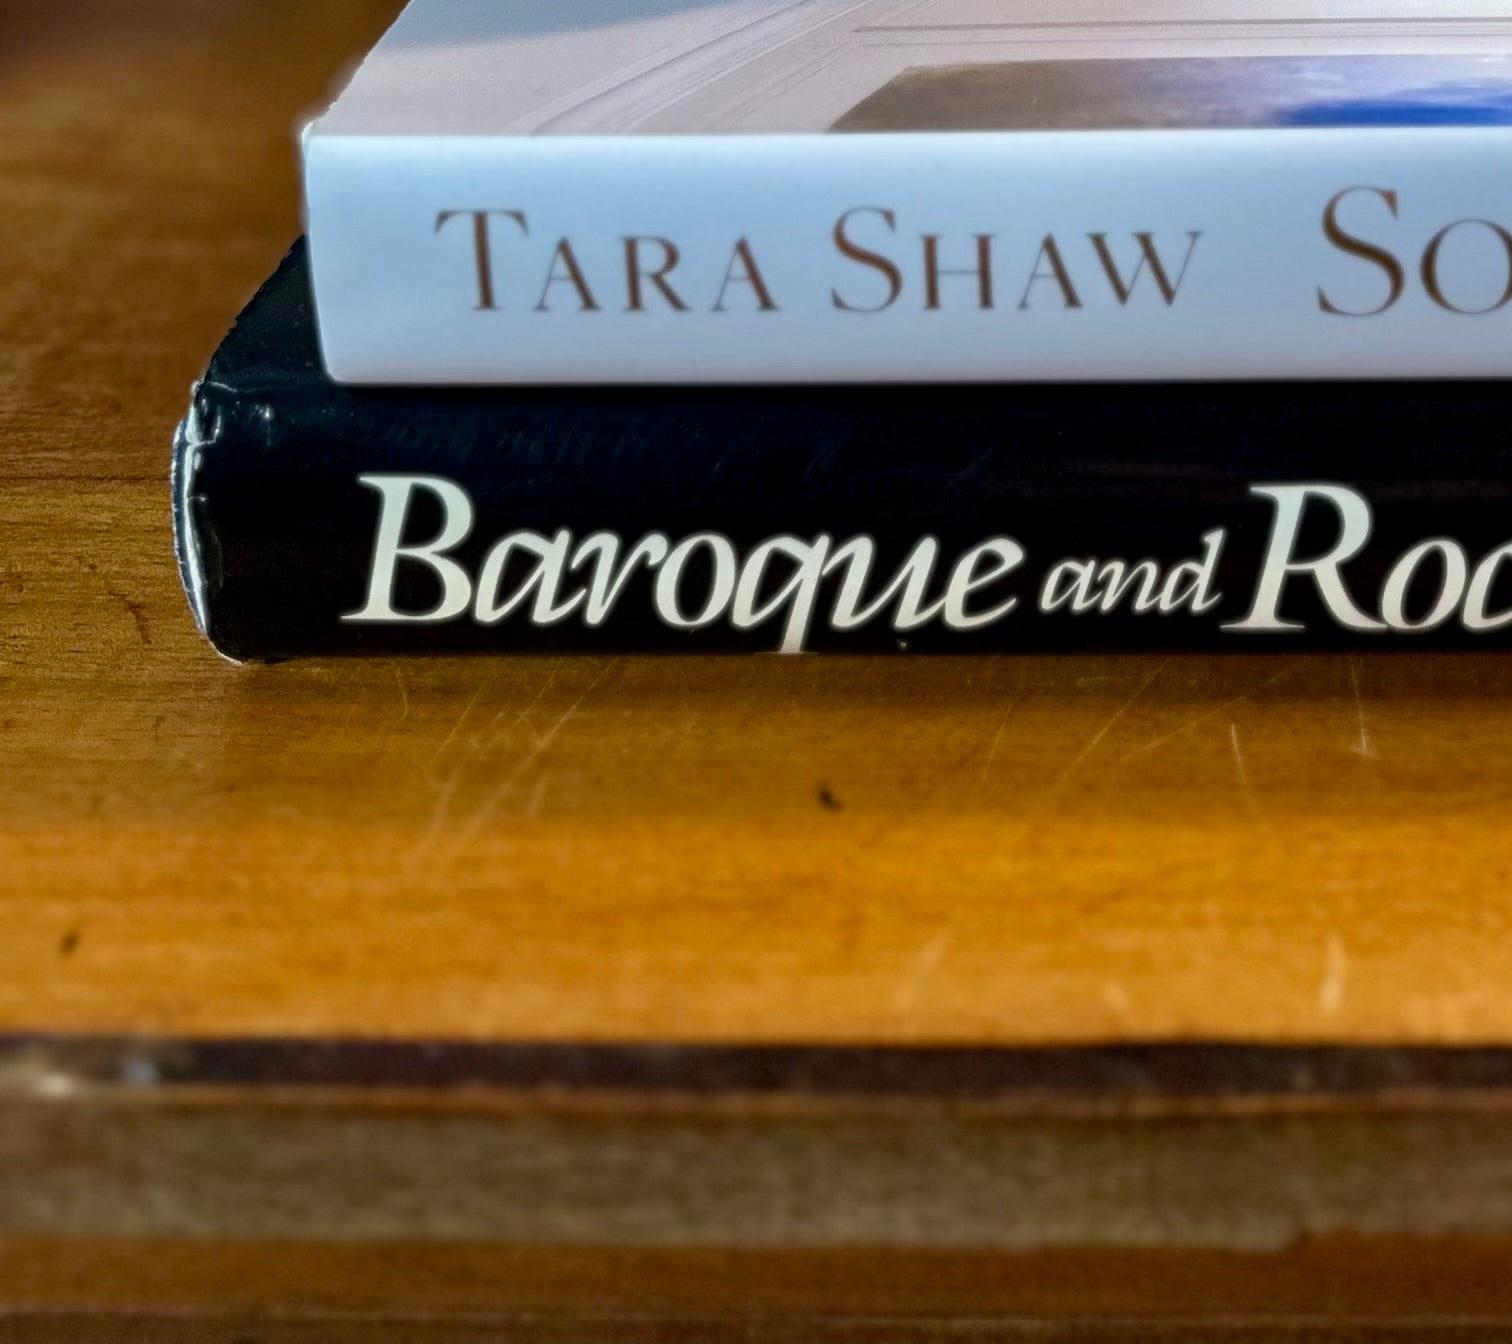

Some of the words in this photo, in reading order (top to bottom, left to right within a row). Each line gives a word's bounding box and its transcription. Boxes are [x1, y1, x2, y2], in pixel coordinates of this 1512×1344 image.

[434, 209, 780, 313] TARA
[830, 206, 1203, 313] SHAW
[341, 474, 1025, 655] Baroque
[1040, 528, 1224, 614] and
